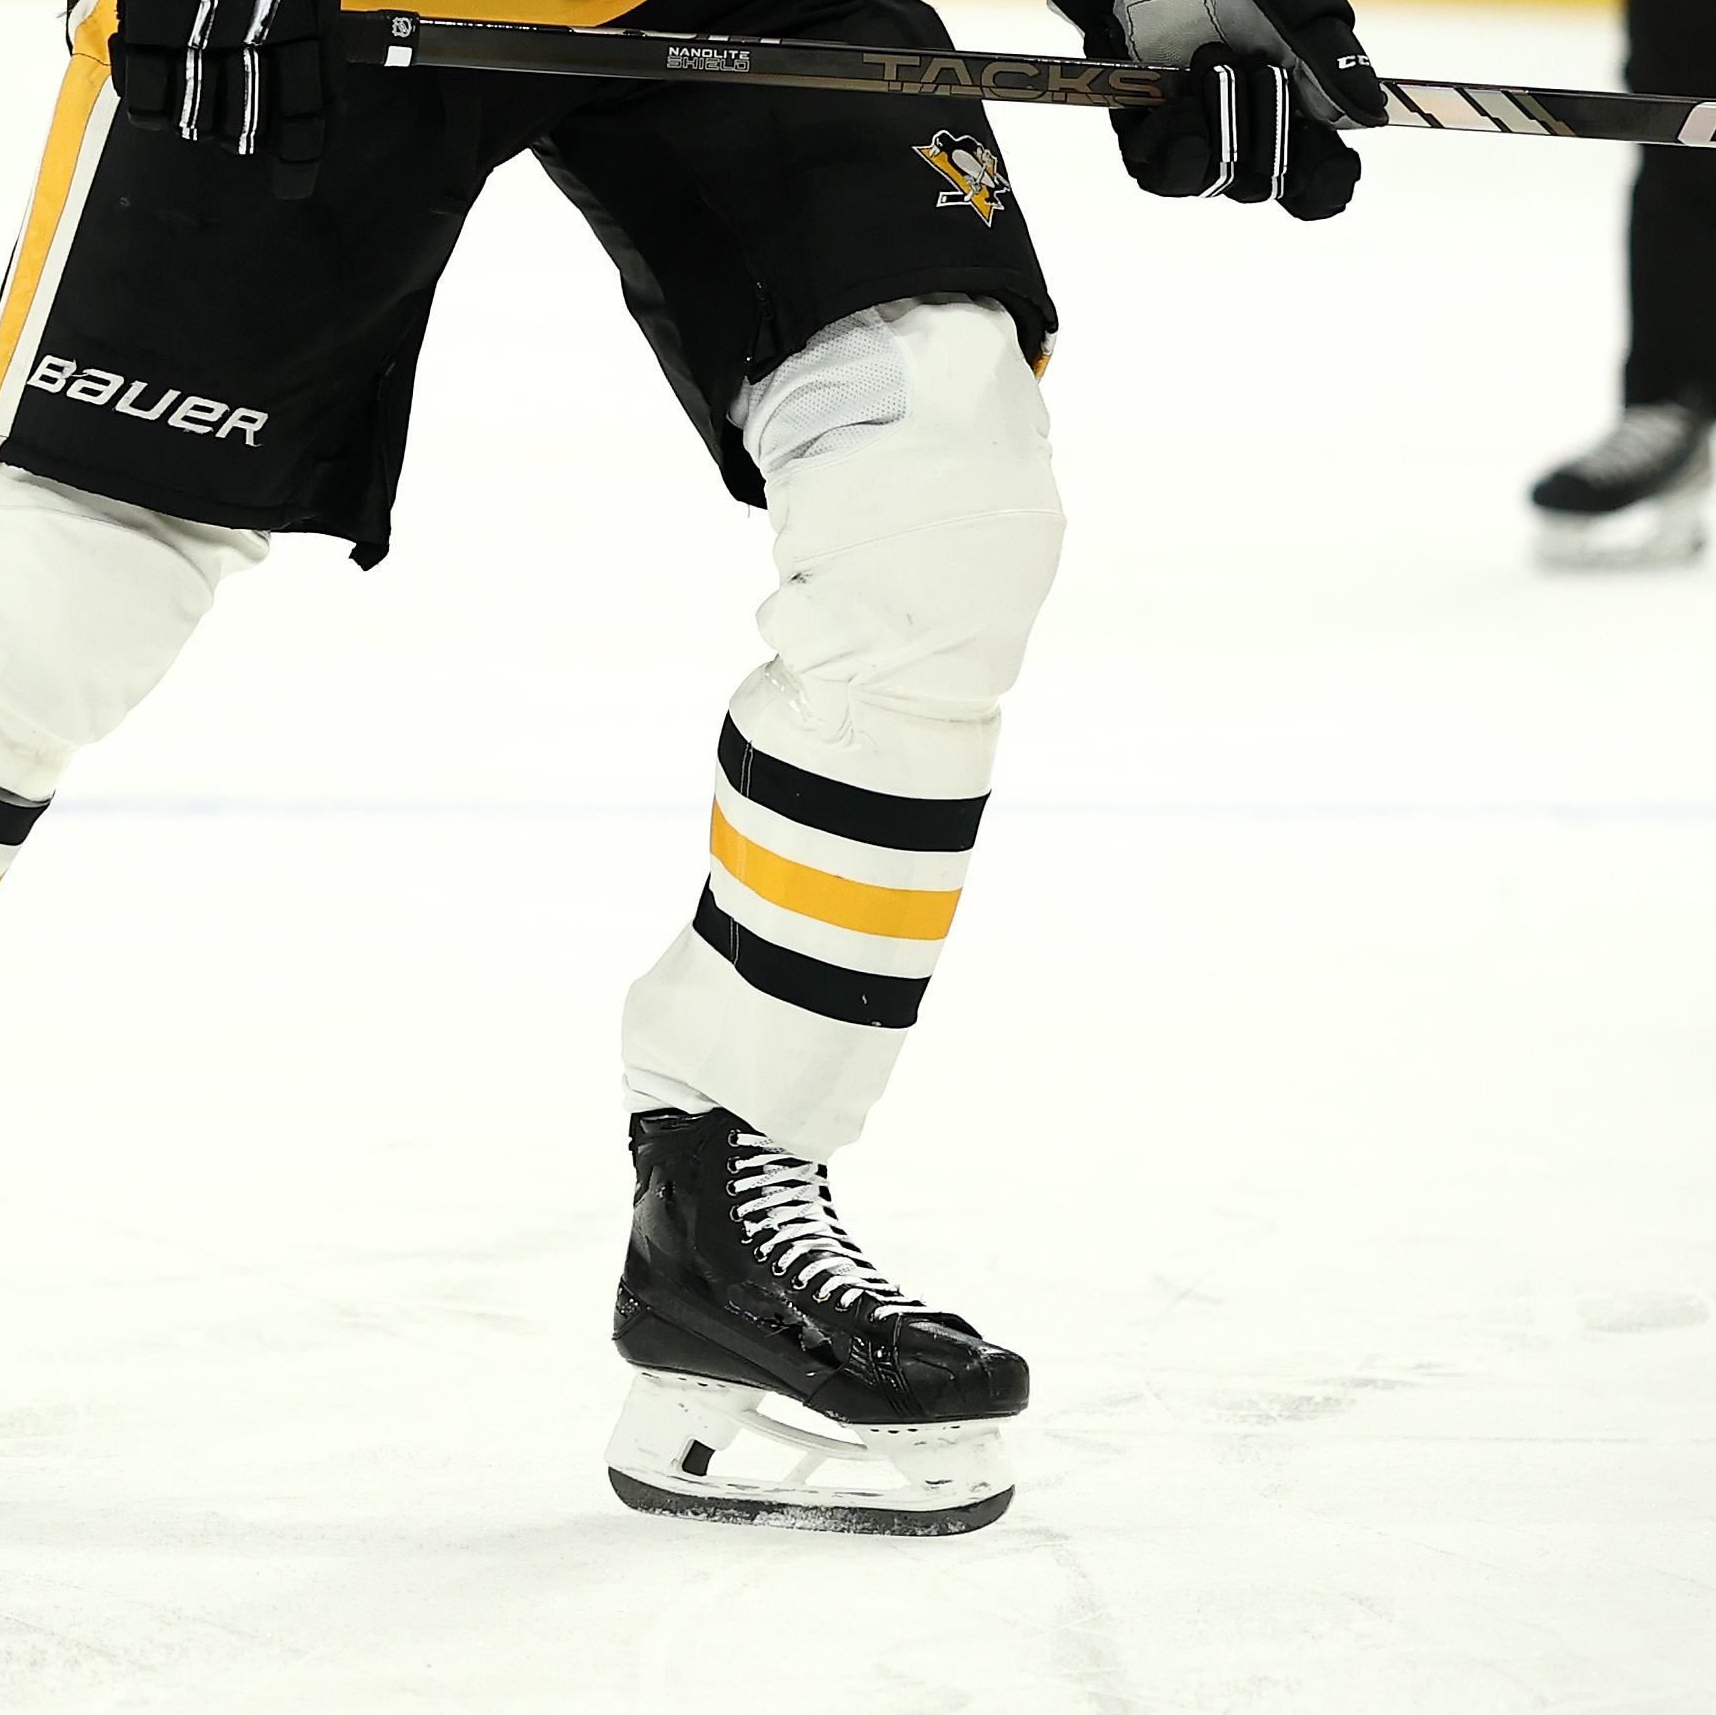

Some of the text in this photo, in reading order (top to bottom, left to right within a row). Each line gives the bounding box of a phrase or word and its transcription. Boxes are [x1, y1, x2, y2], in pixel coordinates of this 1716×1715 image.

[668, 46, 751, 60] NANOLITE
[666, 56, 750, 72] SHIELD
[863, 53, 1165, 108] TACKS
